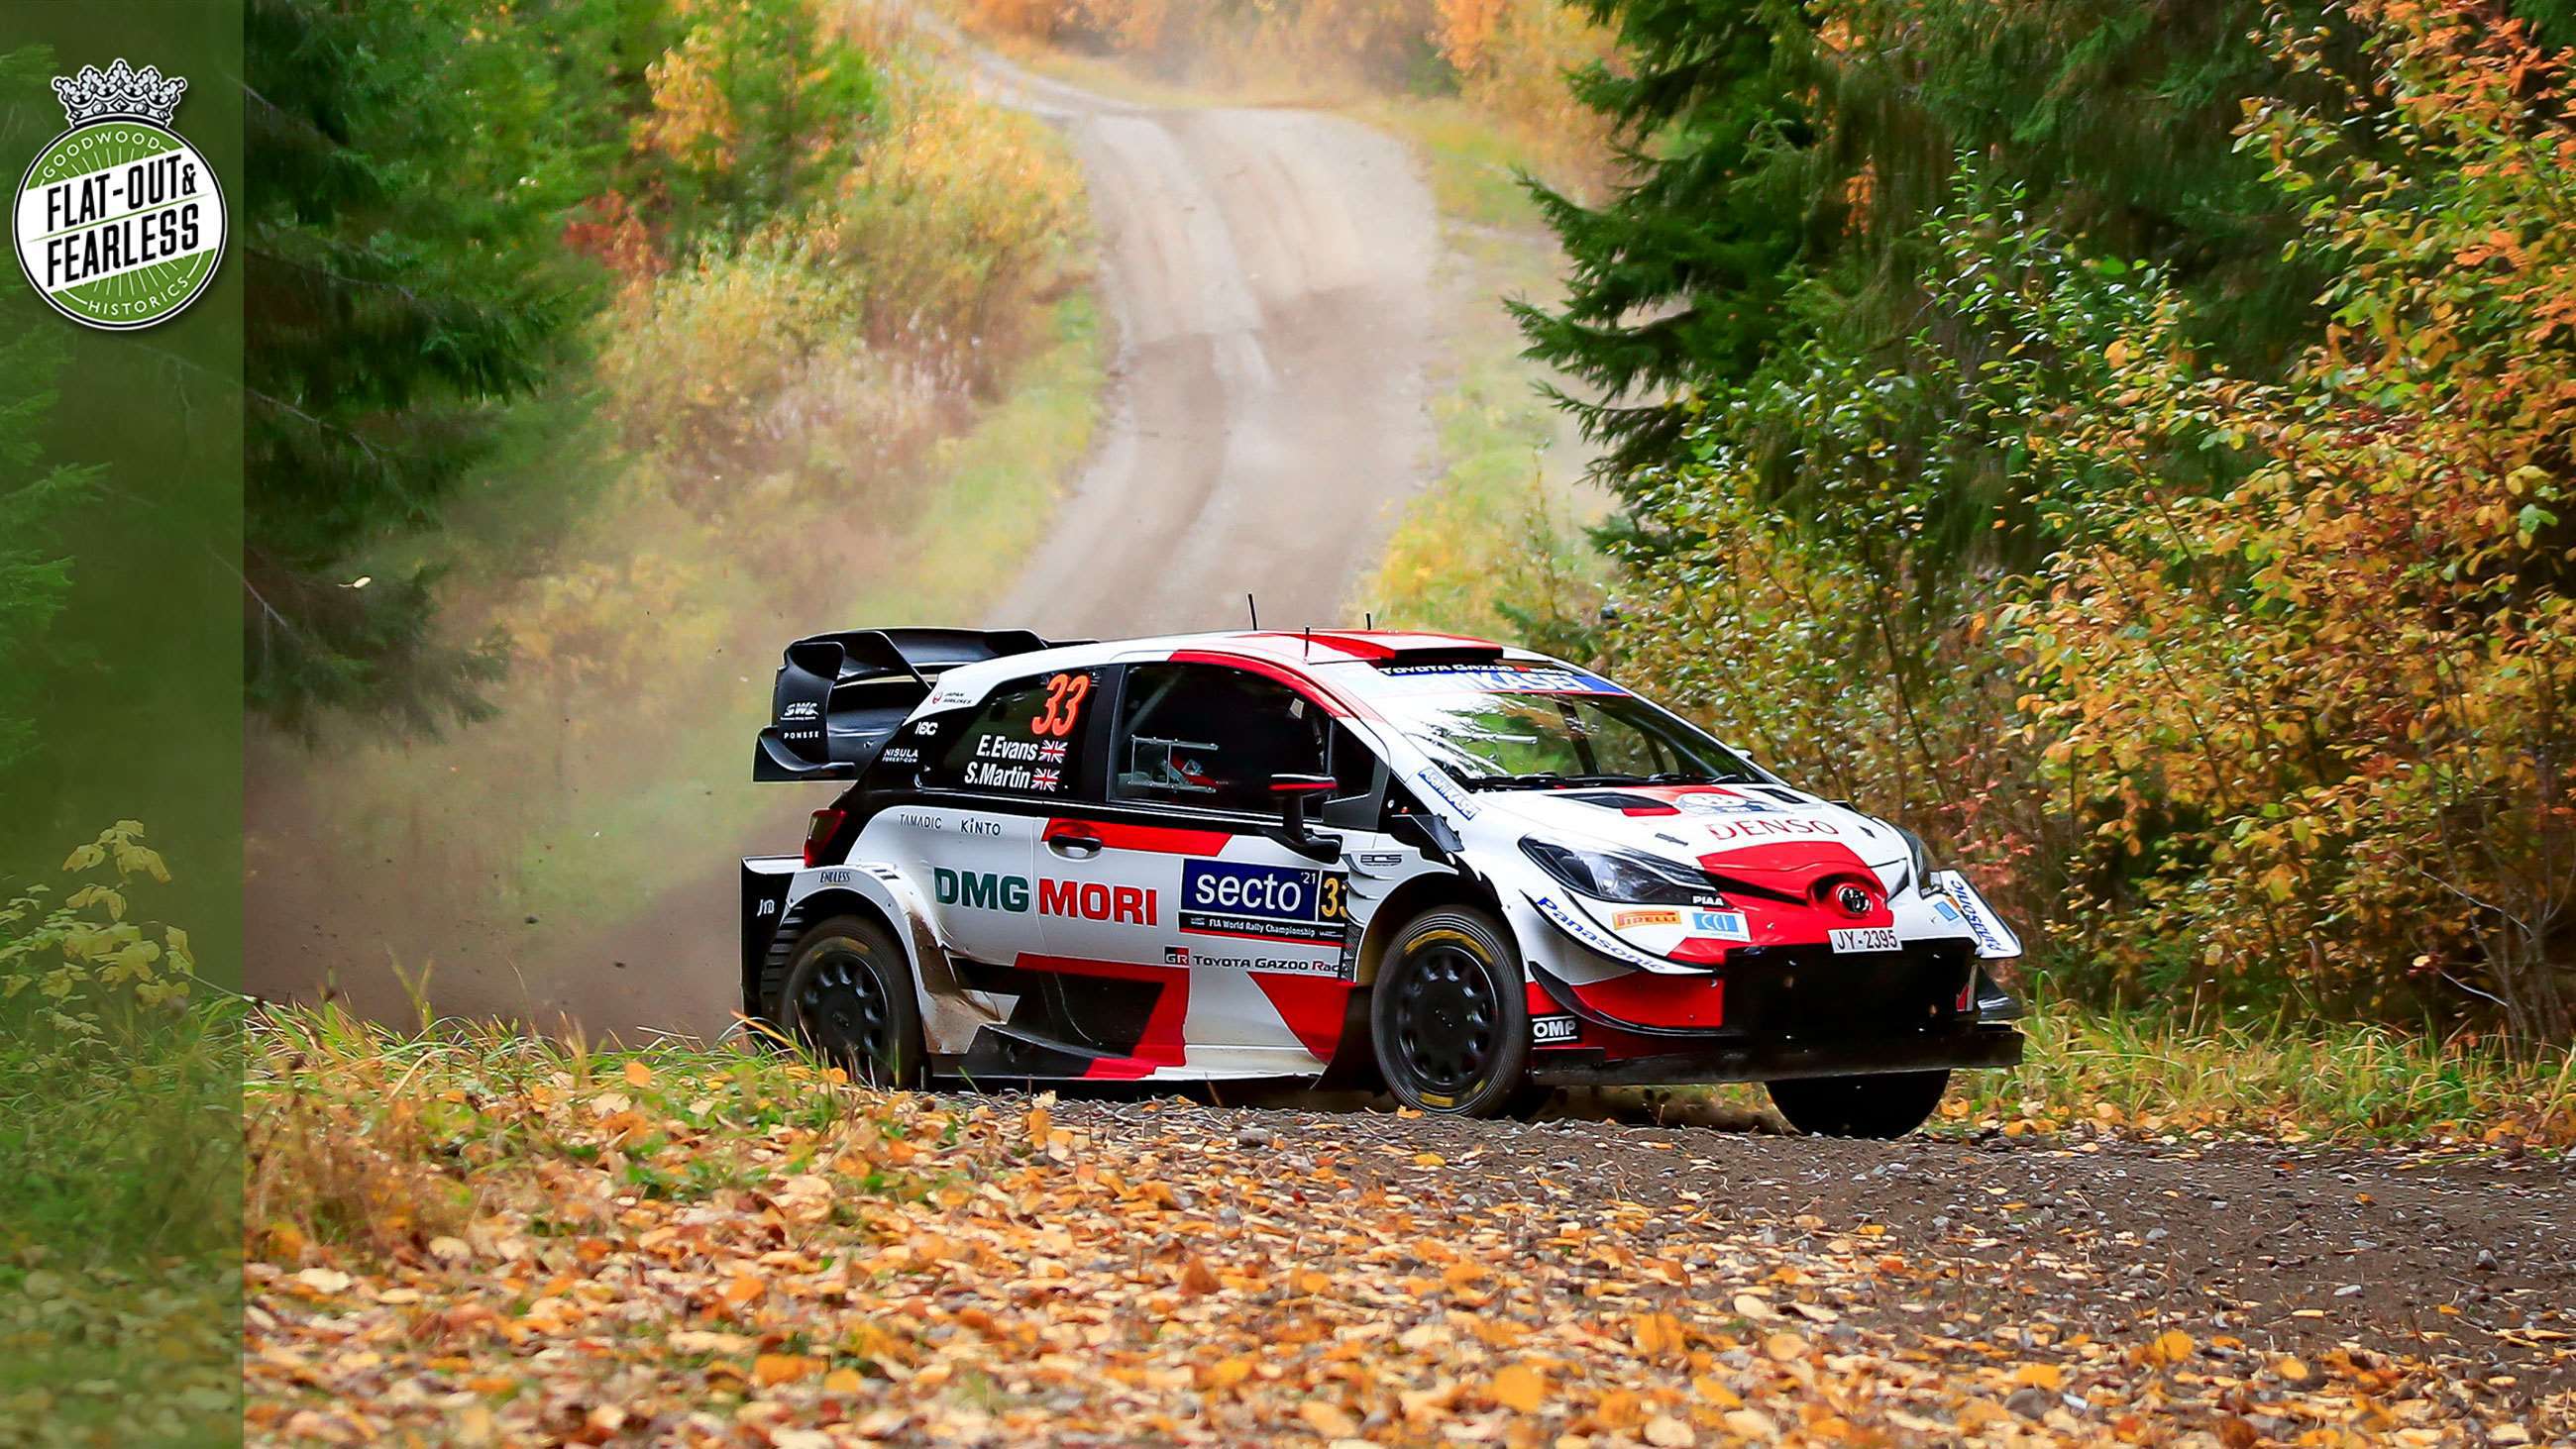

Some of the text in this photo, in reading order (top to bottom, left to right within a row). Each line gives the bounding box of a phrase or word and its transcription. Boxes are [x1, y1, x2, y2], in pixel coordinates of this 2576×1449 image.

[1379, 665, 1450, 675] TOYOTA
[1031, 673, 1090, 736] 33
[884, 749, 917, 758] NISULA
[976, 735, 1038, 761] E.Evans
[964, 762, 1031, 789] S.Martin
[900, 814, 942, 829] TAMADIC
[1705, 819, 1839, 840] DENSO
[933, 867, 1158, 926] DMG MORI
[1195, 873, 1302, 912] secto
[1693, 895, 1724, 906] PIAA
[1949, 880, 2009, 952] Panasonic
[1209, 918, 1222, 927] FIA
[1223, 919, 1244, 930] World
[1245, 921, 1264, 933] Rally
[1265, 924, 1316, 937] Championship
[1537, 896, 1665, 971] Panasonic
[1837, 929, 1898, 950] JY-2395
[1165, 953, 1188, 965] GR
[1193, 955, 1251, 968] TOYOTA
[1254, 958, 1309, 971] GAZOO
[1533, 1020, 1576, 1038] OMP
